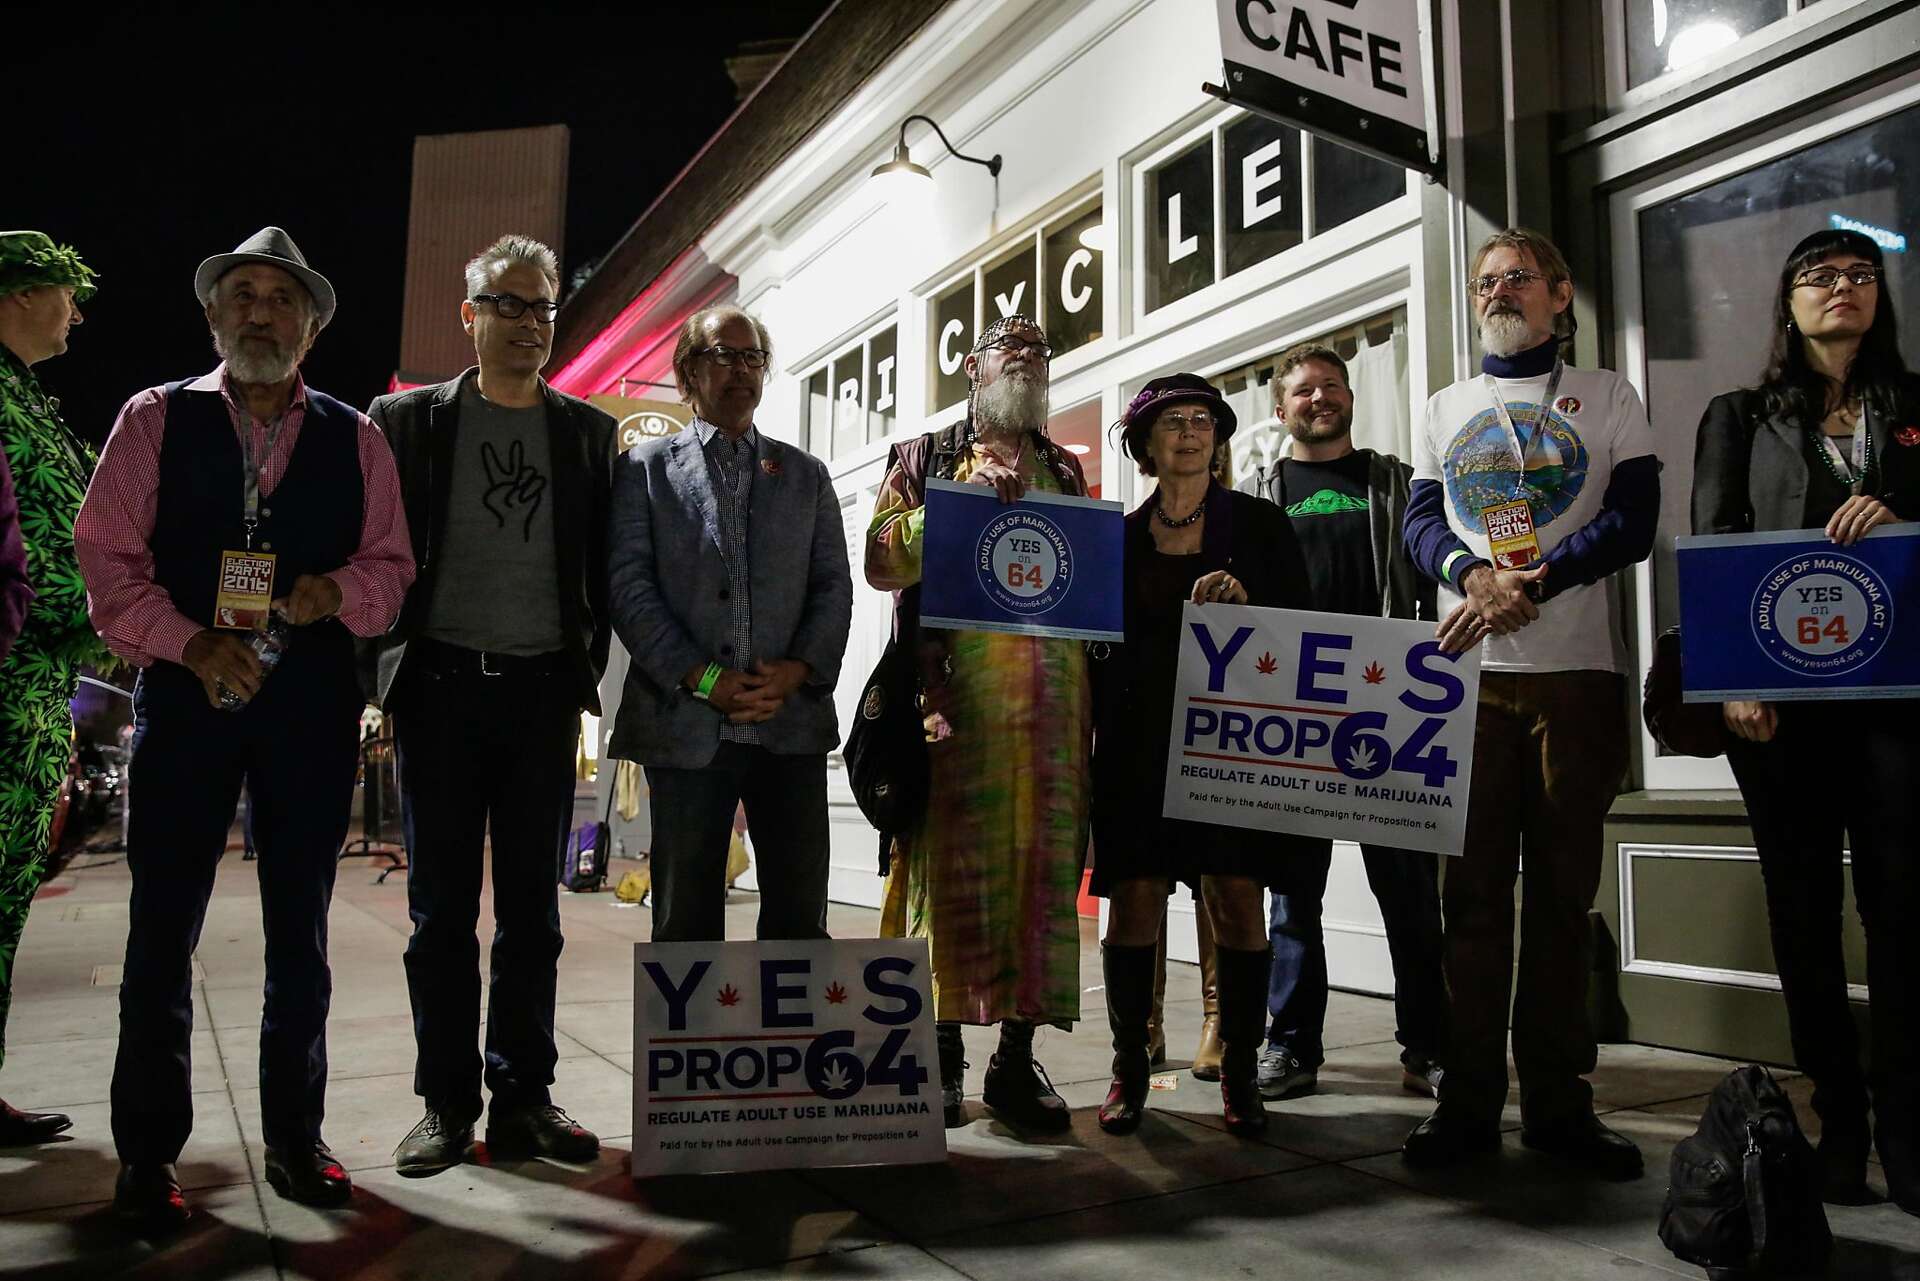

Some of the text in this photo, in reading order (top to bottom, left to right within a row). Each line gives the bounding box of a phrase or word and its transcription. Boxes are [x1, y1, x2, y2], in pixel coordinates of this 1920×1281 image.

[1235, 0, 1408, 98] CAFE
[1487, 505, 1526, 520] ELECTION
[1488, 511, 1527, 527] PARTY
[1490, 521, 1530, 539] 2016
[981, 516, 1068, 580] ADULT USE OF MARIJUANA ACT
[1009, 538, 1041, 554] YES
[226, 557, 272, 568] ELECTION
[1018, 554, 1031, 564] on
[225, 565, 271, 578] PARTY
[1007, 563, 1043, 589] 64
[223, 574, 269, 591] 2016
[1759, 559, 1885, 631] ADULT USE OF MARIJUANA ACT
[1796, 586, 1843, 603] YES
[1811, 605, 1829, 615] on
[1796, 615, 1849, 645] 64
[1781, 648, 1865, 669] www.yeson64.org
[1183, 706, 1458, 788] PROP 64
[1180, 764, 1453, 808] REGULATE ADULT USE MARIJUANA
[1189, 791, 1437, 831] Paid for by the Adult Use Campaign for Proposition 64
[648, 1028, 928, 1100] PROP 64
[648, 1102, 930, 1126] REGULATE ADULT USE MARIJUANA
[659, 1129, 919, 1150] Paid for by the Adult Use Campaign for Proposition 64
